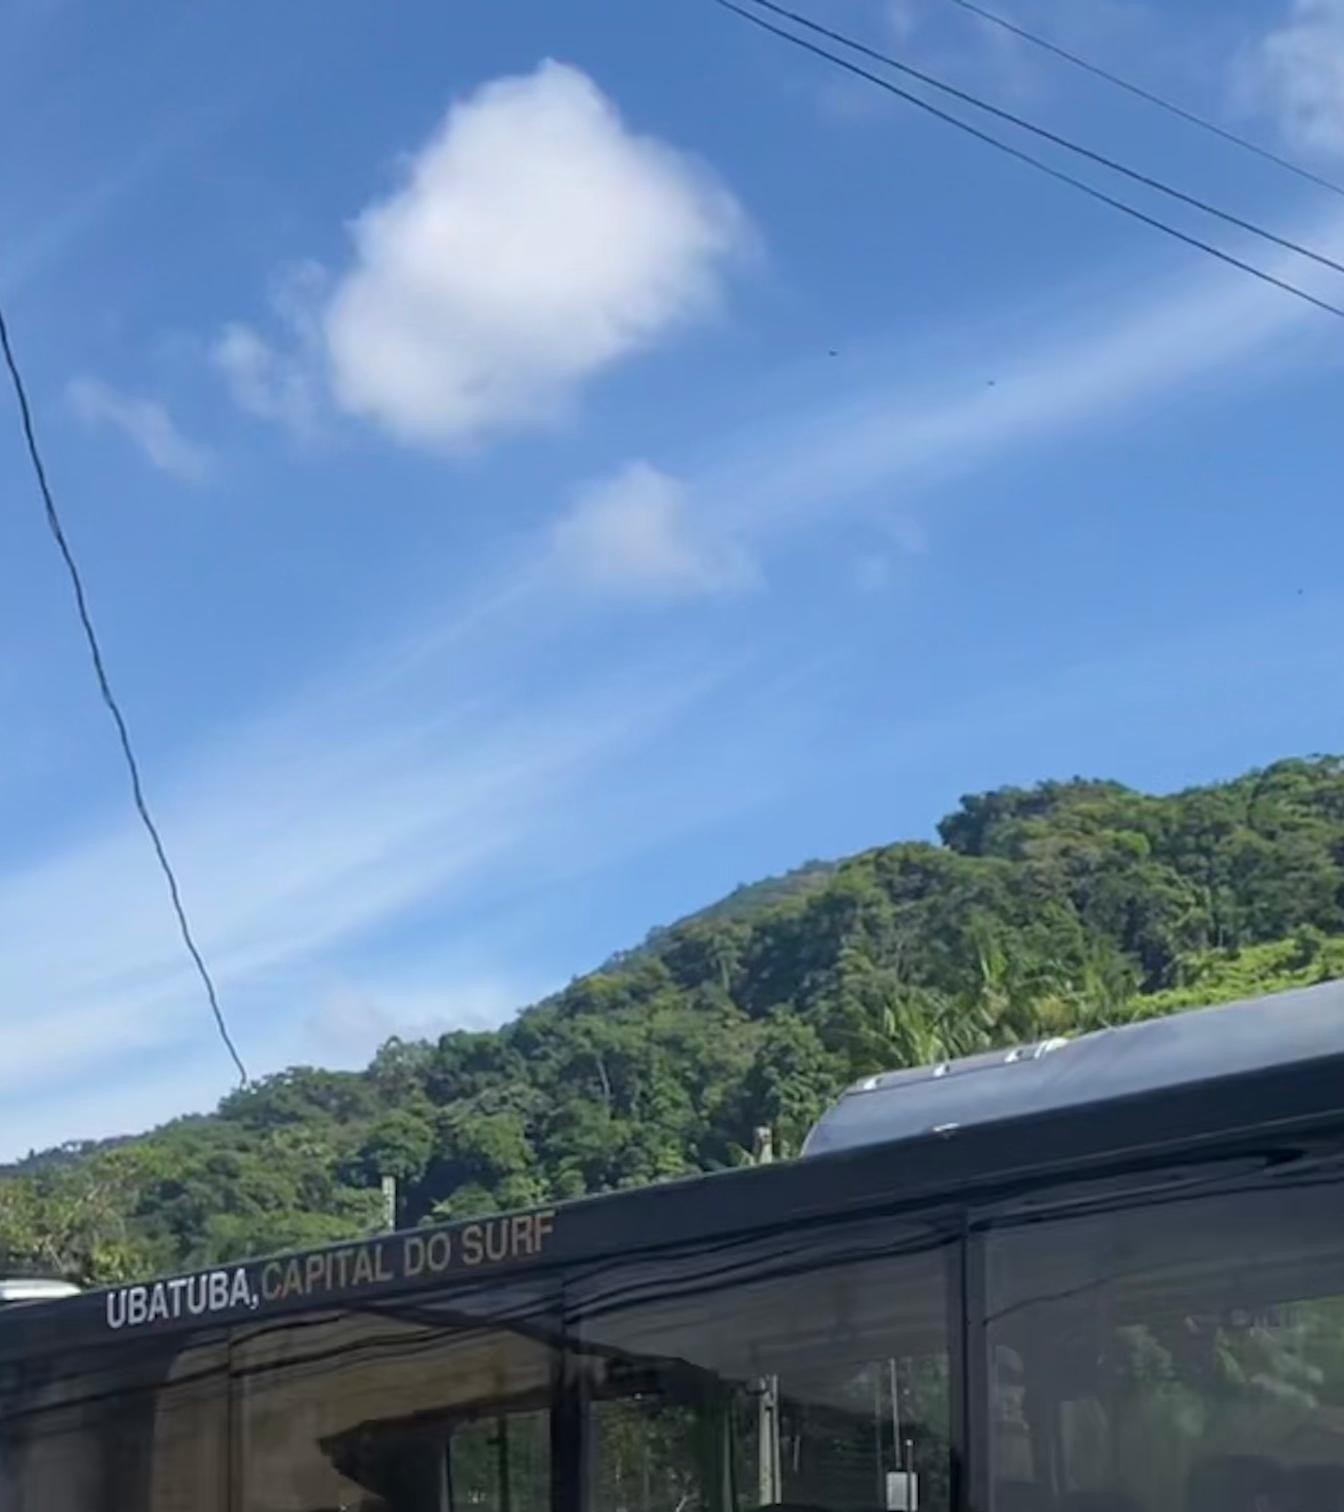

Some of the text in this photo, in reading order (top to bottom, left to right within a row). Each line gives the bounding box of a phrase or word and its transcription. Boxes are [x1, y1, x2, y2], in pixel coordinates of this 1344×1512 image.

[106, 1210, 556, 1329] UBATUBA, CAPITAL DO SURF
